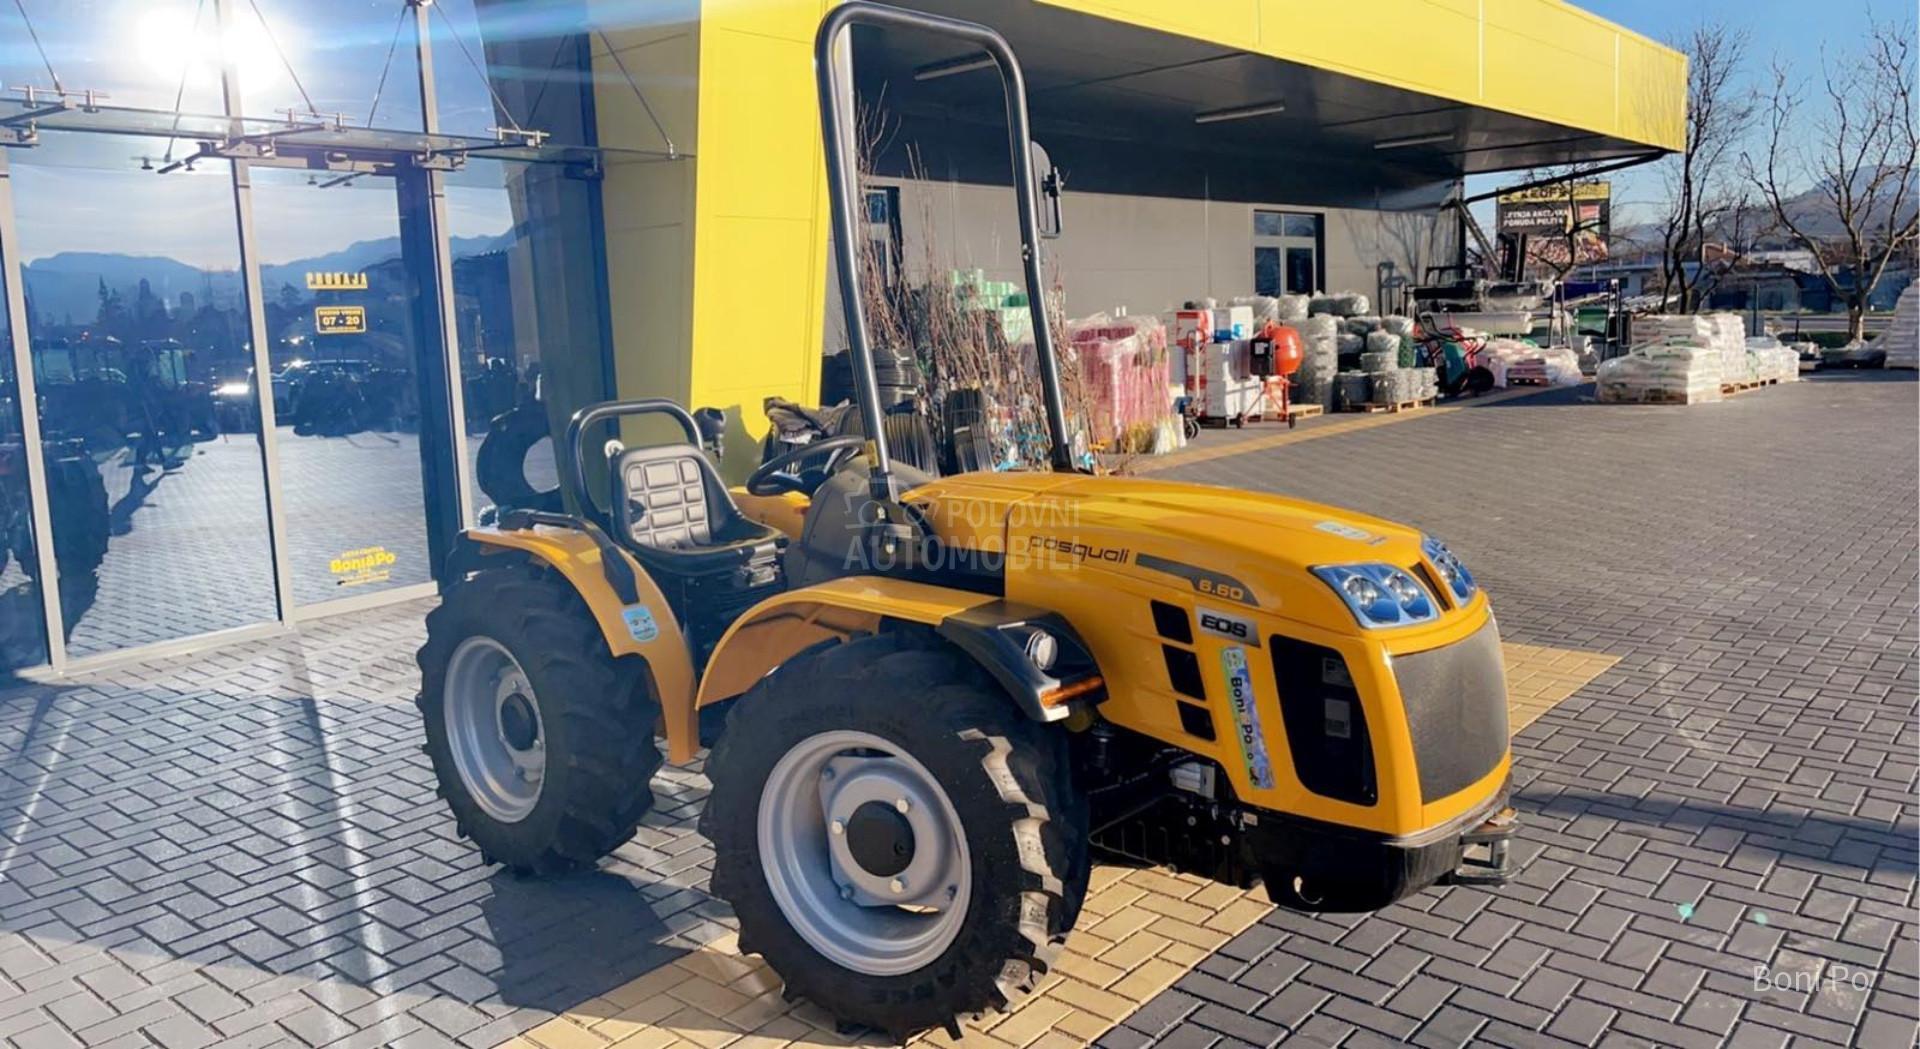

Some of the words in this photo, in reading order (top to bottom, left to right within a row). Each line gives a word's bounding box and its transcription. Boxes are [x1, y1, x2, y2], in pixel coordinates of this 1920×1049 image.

[322, 316, 337, 326] 07
[345, 315, 360, 325] 20
[1027, 536, 1131, 564] pasquali
[1199, 580, 1244, 601] 6.60
[1201, 613, 1248, 638] EOS
[1230, 676, 1246, 713] Boni
